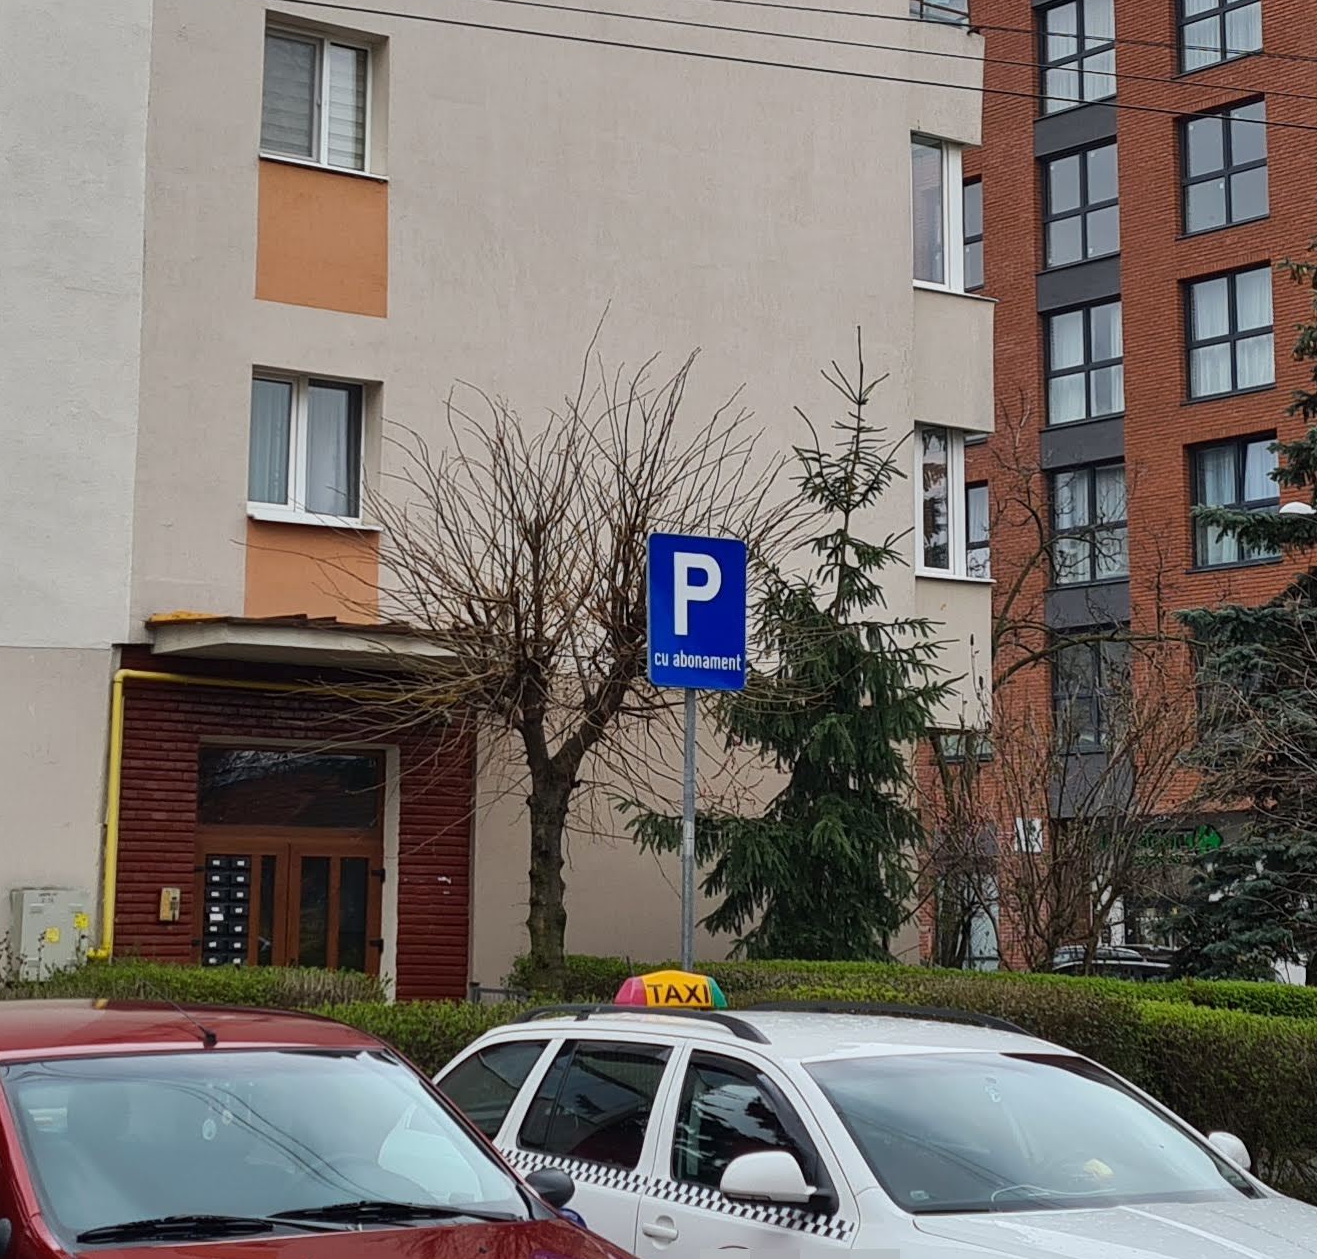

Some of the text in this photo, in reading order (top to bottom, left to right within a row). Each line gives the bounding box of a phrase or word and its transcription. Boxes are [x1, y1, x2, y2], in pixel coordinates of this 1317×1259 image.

[674, 552, 721, 635] P
[654, 650, 741, 671] cu abonament
[647, 984, 710, 1004] TAXI
